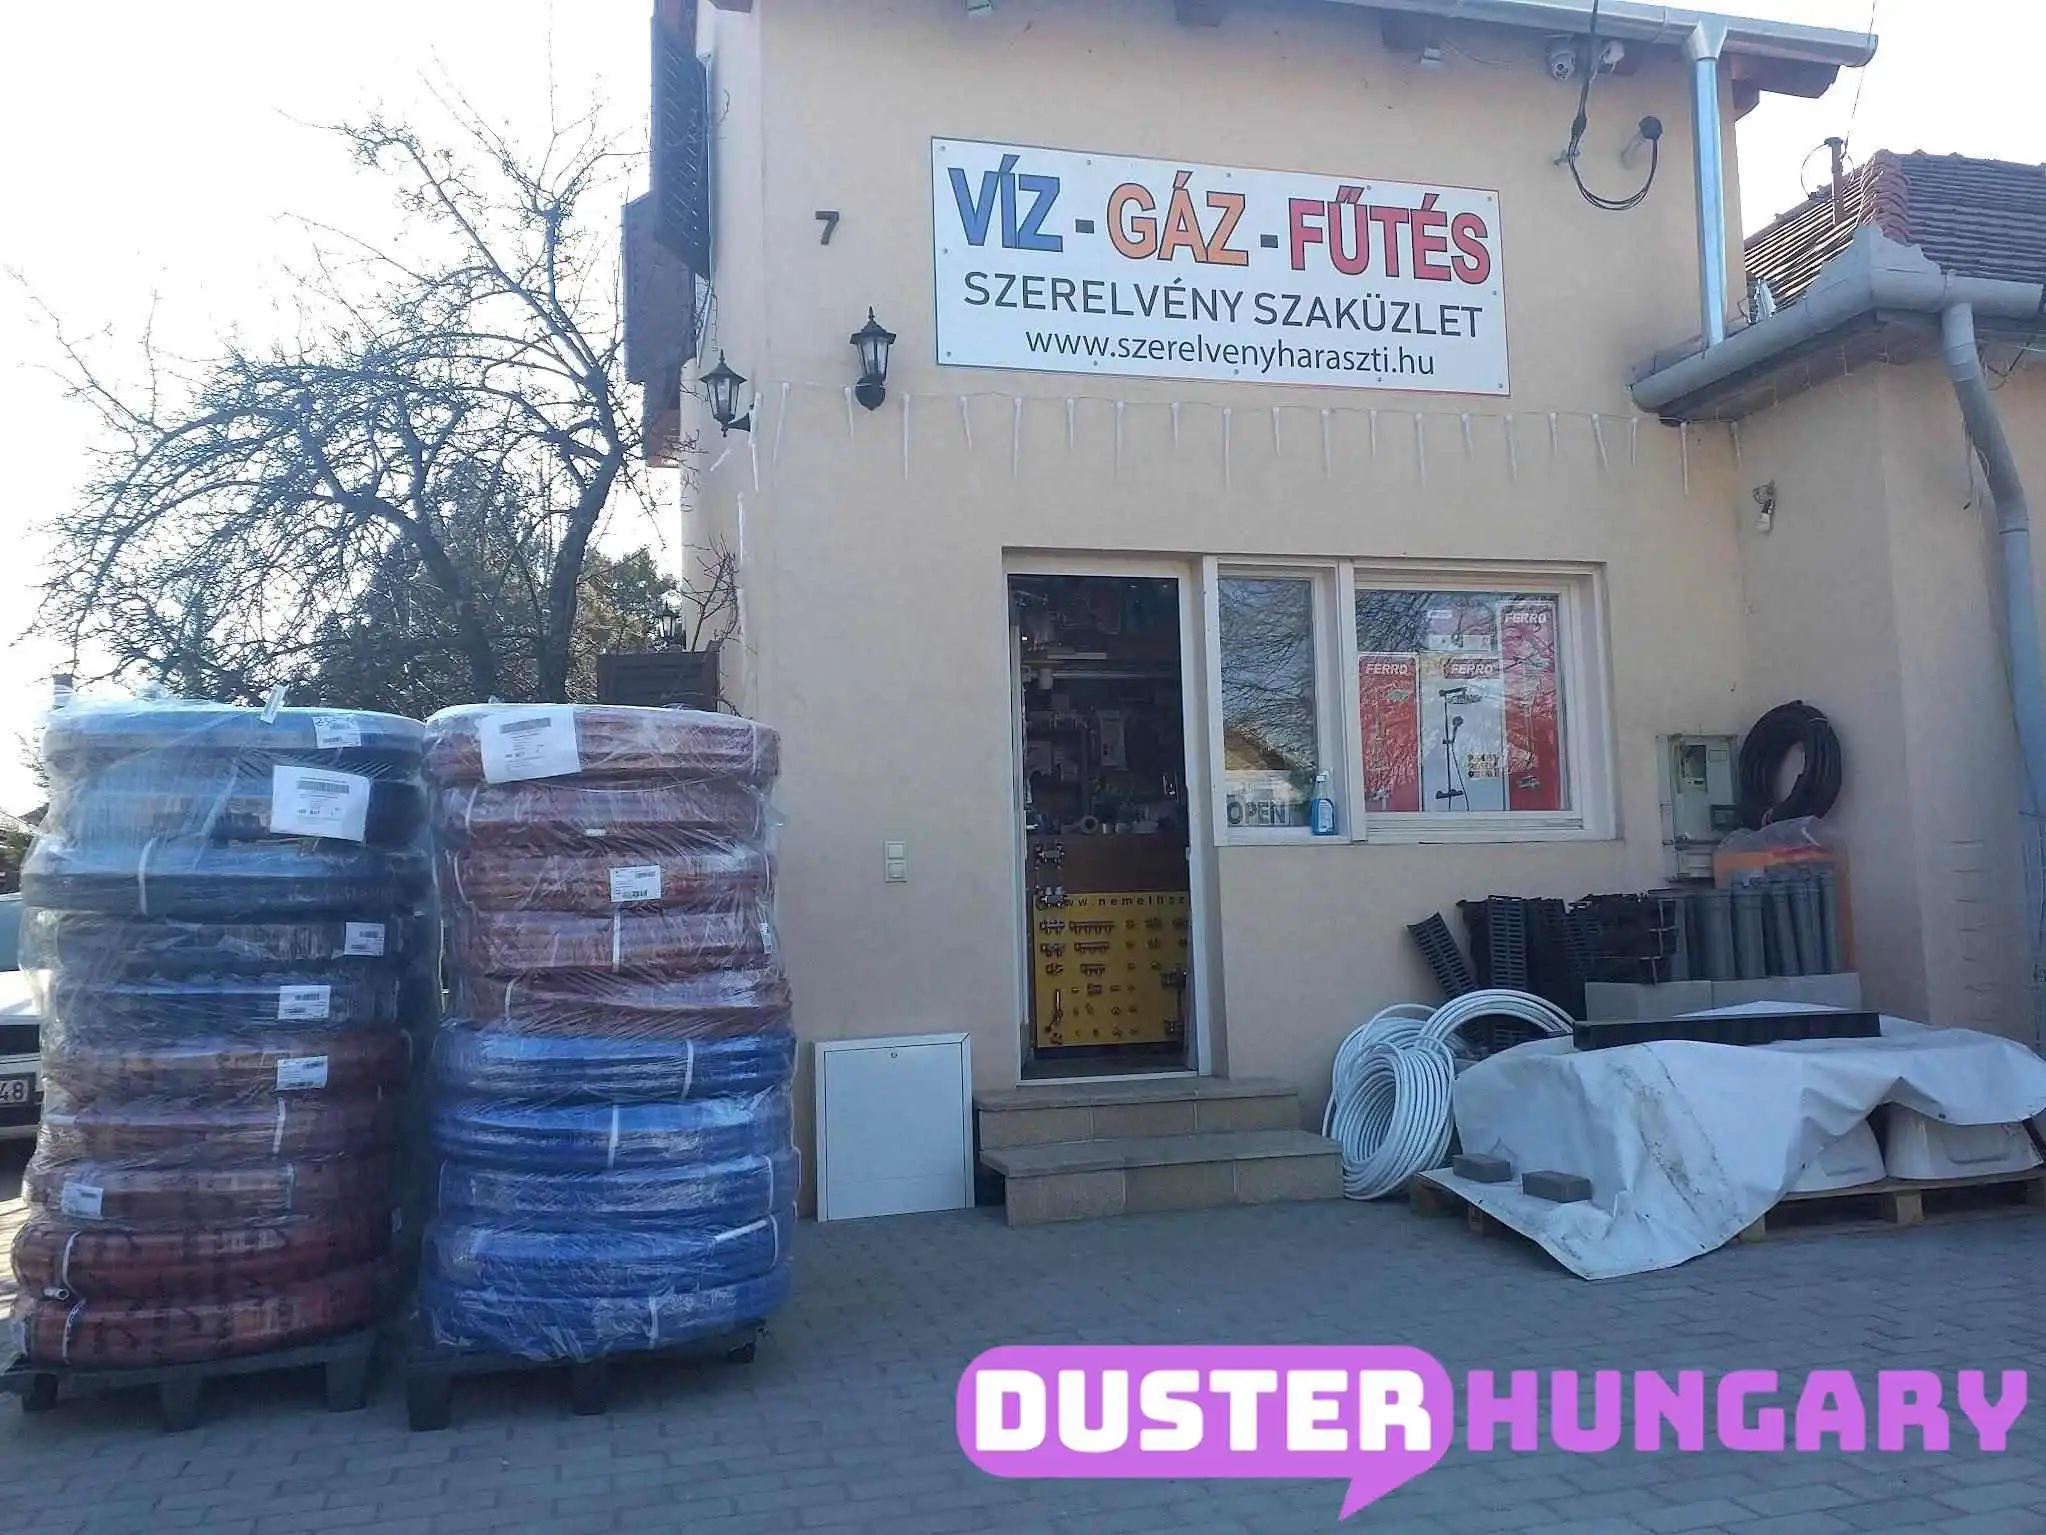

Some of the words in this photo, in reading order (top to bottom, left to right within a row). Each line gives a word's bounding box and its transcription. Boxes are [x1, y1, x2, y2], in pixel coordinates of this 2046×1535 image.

[815, 210, 840, 245] 7
[947, 154, 1063, 253] VÍZ
[1107, 170, 1249, 266] GÁZ
[1288, 185, 1492, 284] FŰTÉS
[964, 271, 1244, 323] SZERELVÉNY
[1254, 292, 1483, 338] SZAKÜZLET
[1025, 331, 1434, 375] www.szerelvenyharaszti.hu
[1504, 612, 1547, 624] FERRO
[1365, 663, 1408, 675] FERRO
[1450, 663, 1494, 675] FERRO
[1226, 800, 1286, 825] OPEN
